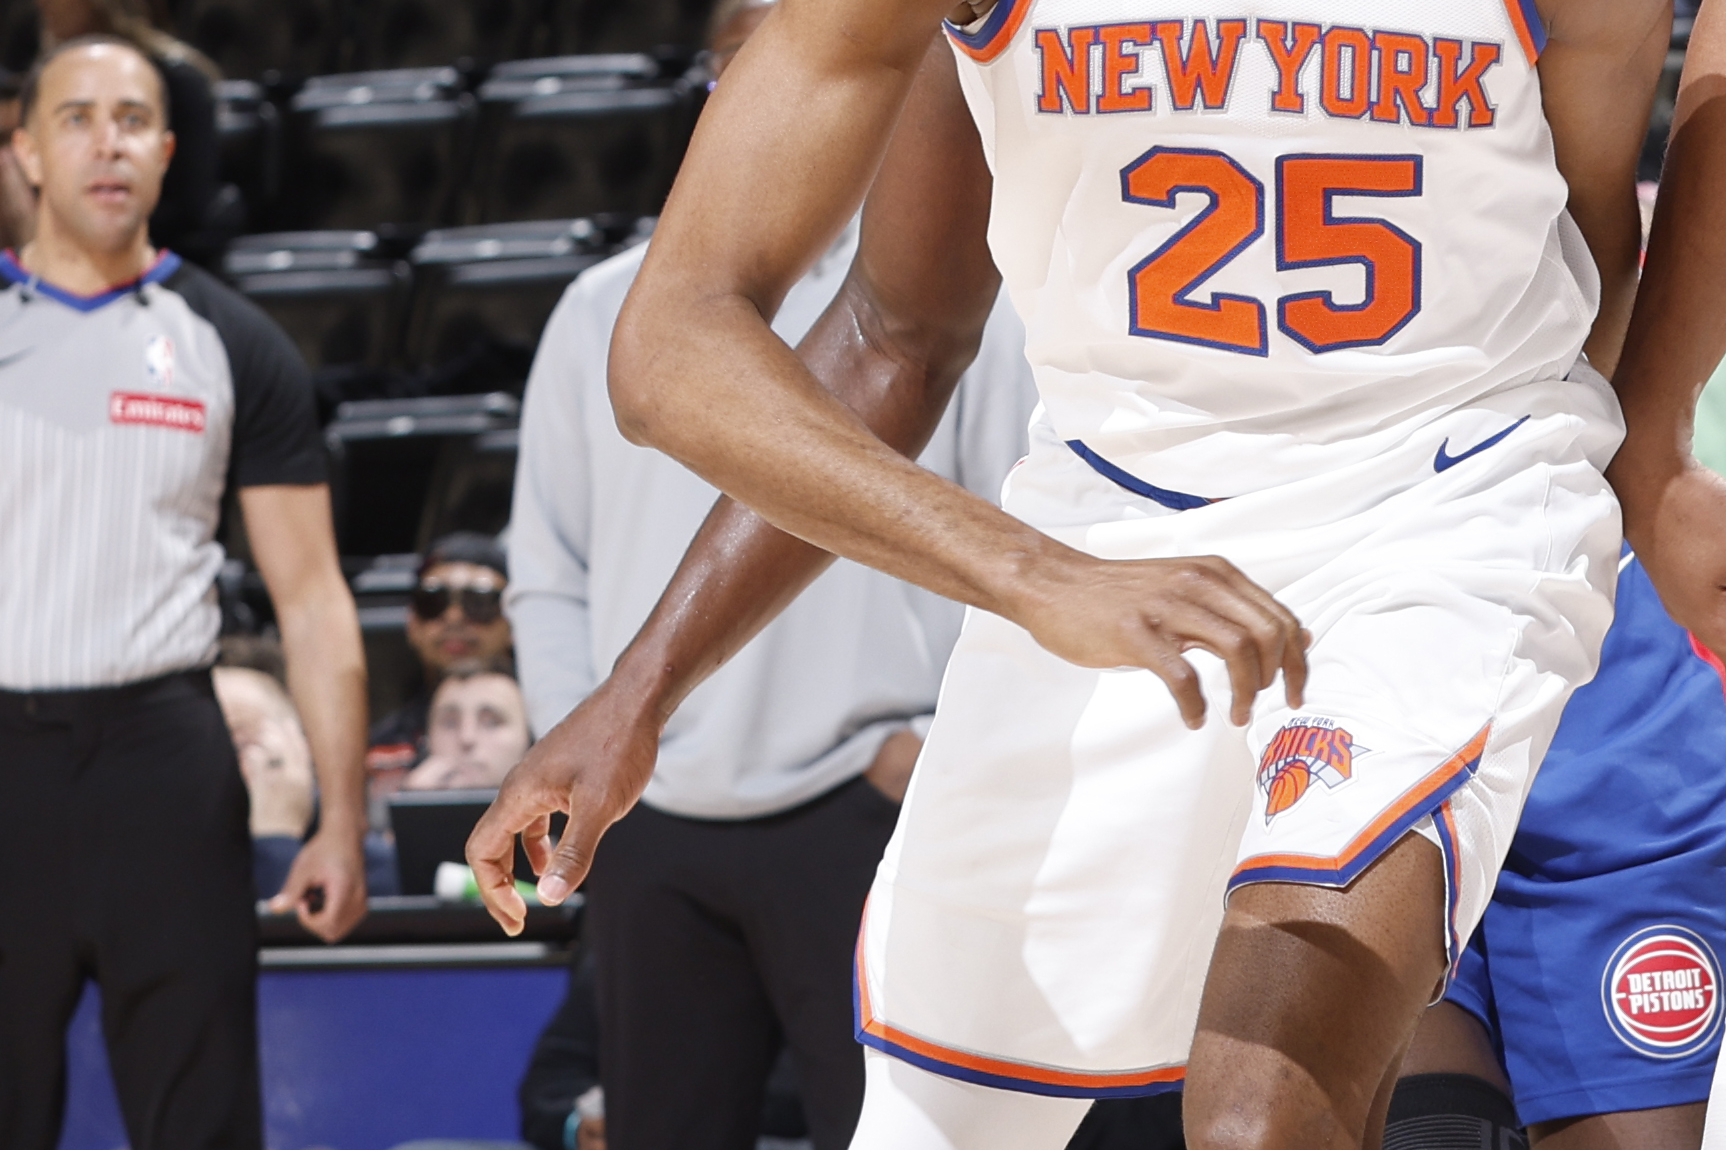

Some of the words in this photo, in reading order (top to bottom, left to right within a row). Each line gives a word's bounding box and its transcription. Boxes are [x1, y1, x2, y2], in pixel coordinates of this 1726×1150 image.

[1034, 18, 1247, 115] NEW
[1256, 18, 1502, 129] YORK
[1120, 145, 1422, 357] 25
[1626, 968, 1702, 994] DETROIT
[1628, 988, 1705, 1015] PISTONS
